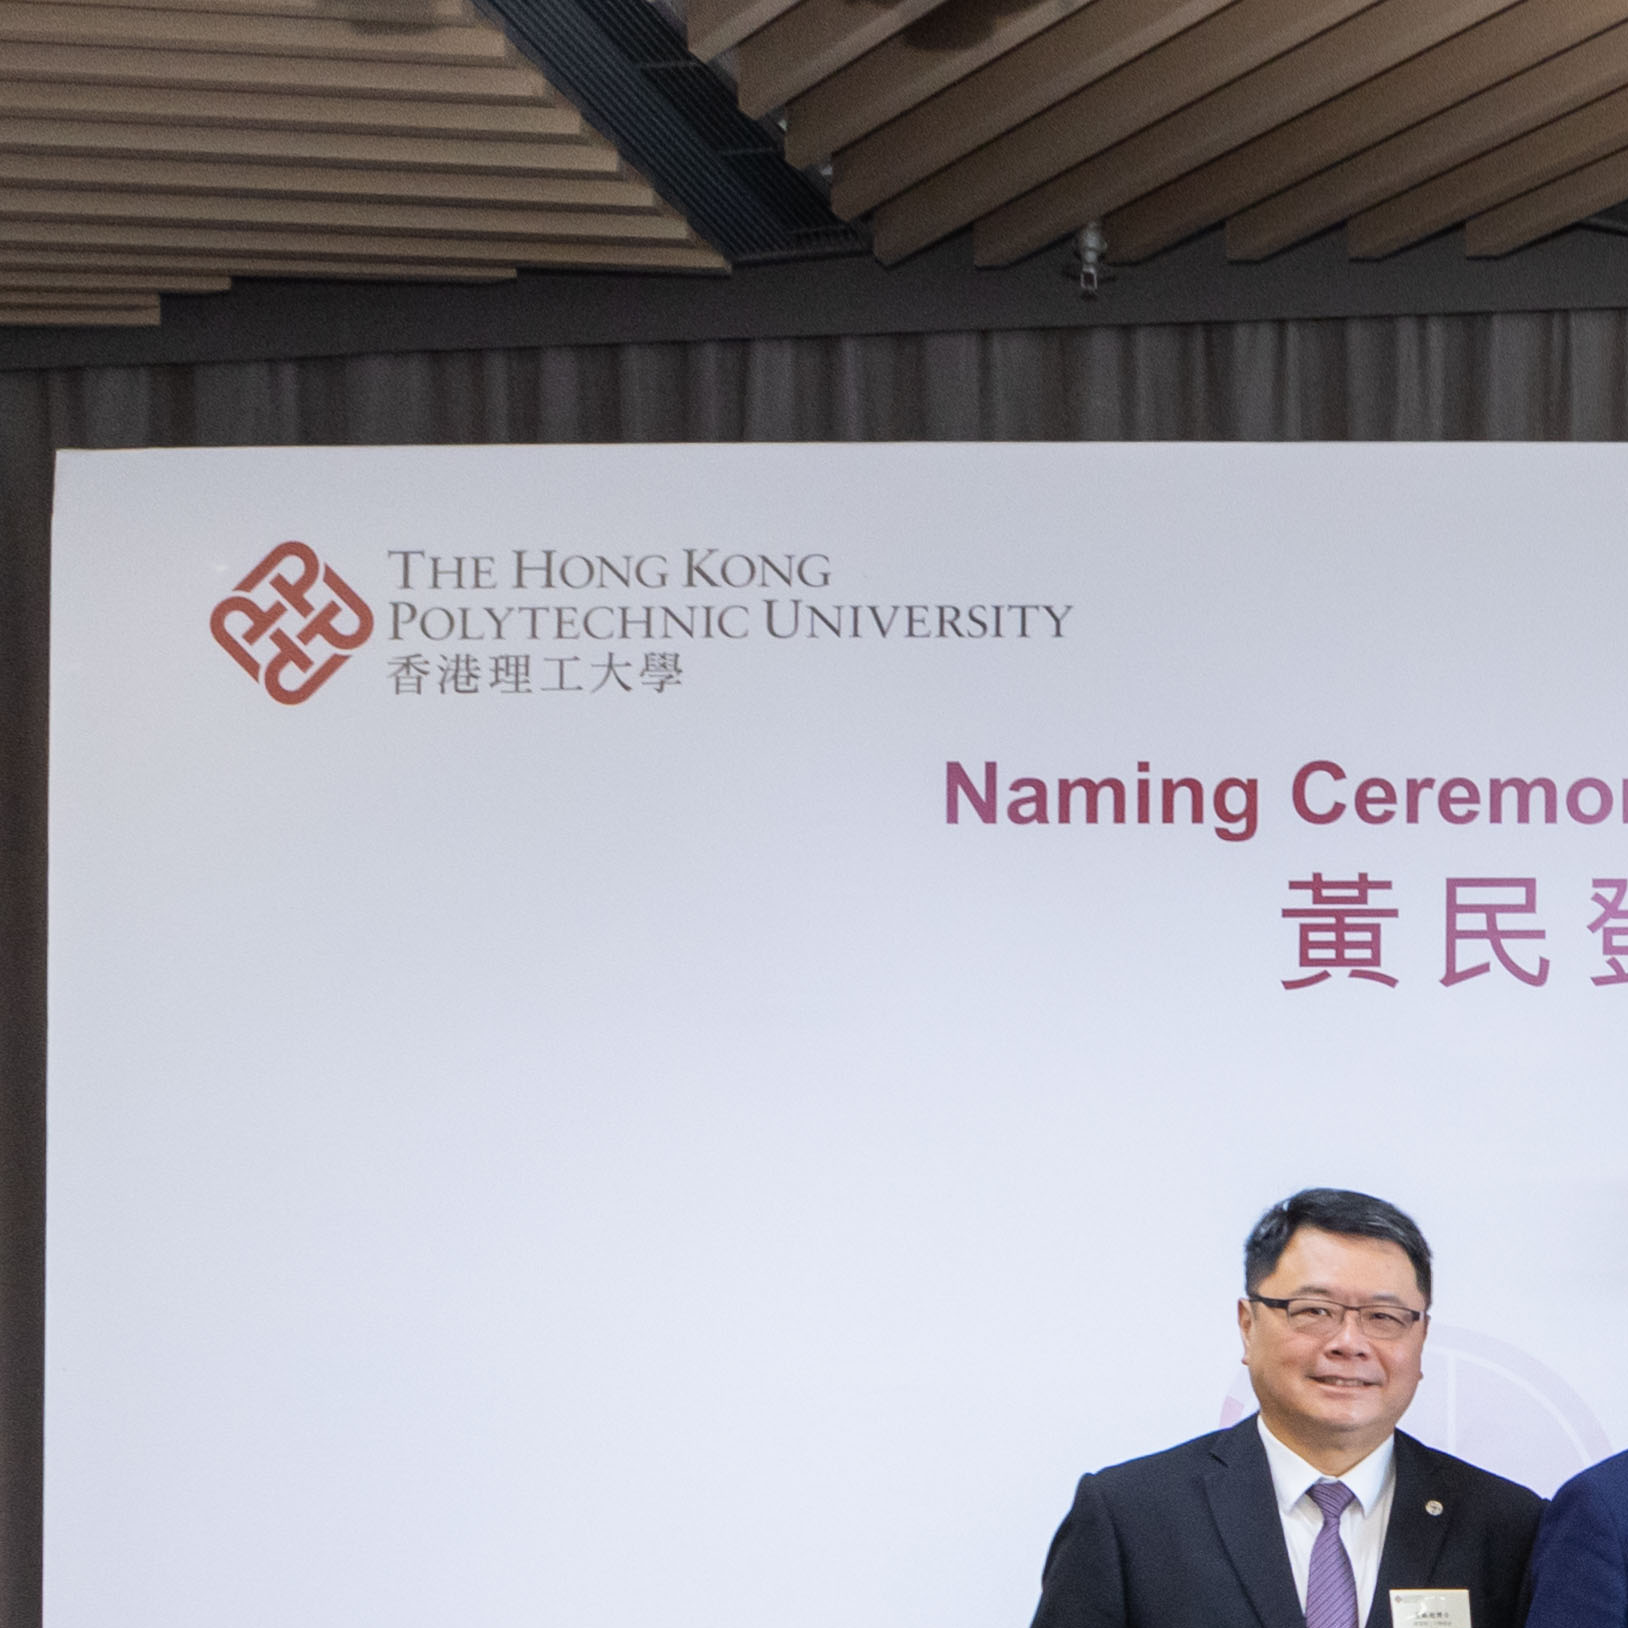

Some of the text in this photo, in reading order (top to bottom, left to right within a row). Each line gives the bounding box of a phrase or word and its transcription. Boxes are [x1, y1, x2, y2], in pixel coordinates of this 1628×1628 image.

[388, 549, 832, 591] THE HONG KONG
[390, 600, 1074, 641] POLYTECHNIC UNIVERSITY
[386, 651, 684, 697] 香港理工大學
[946, 761, 1260, 843] Naming
